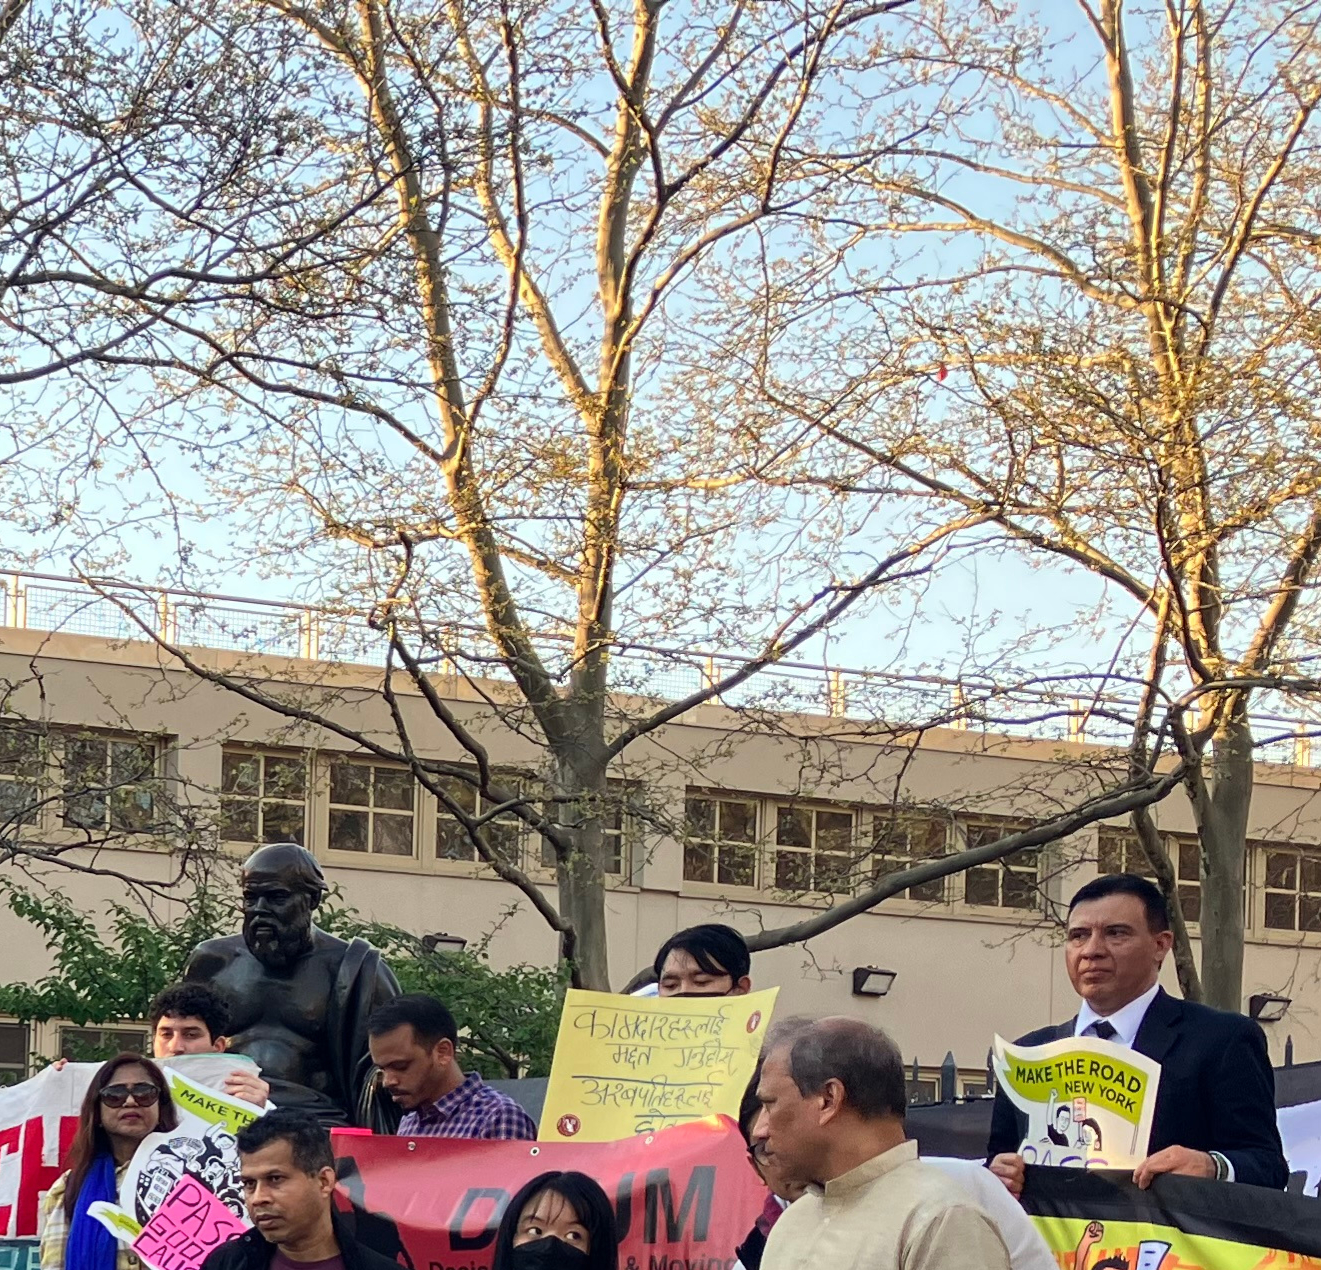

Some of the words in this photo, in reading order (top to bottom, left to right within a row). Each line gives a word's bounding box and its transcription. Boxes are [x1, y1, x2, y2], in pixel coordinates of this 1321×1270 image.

[1015, 1065, 1054, 1083] MAKE
[1055, 1058, 1086, 1078] THE
[1089, 1060, 1141, 1094] ROAD
[180, 1089, 231, 1117] MAKE
[233, 1109, 257, 1128] TH
[1064, 1080, 1095, 1095] NEW
[1099, 1084, 1138, 1114] YORK
[148, 1213, 207, 1261] GOO
